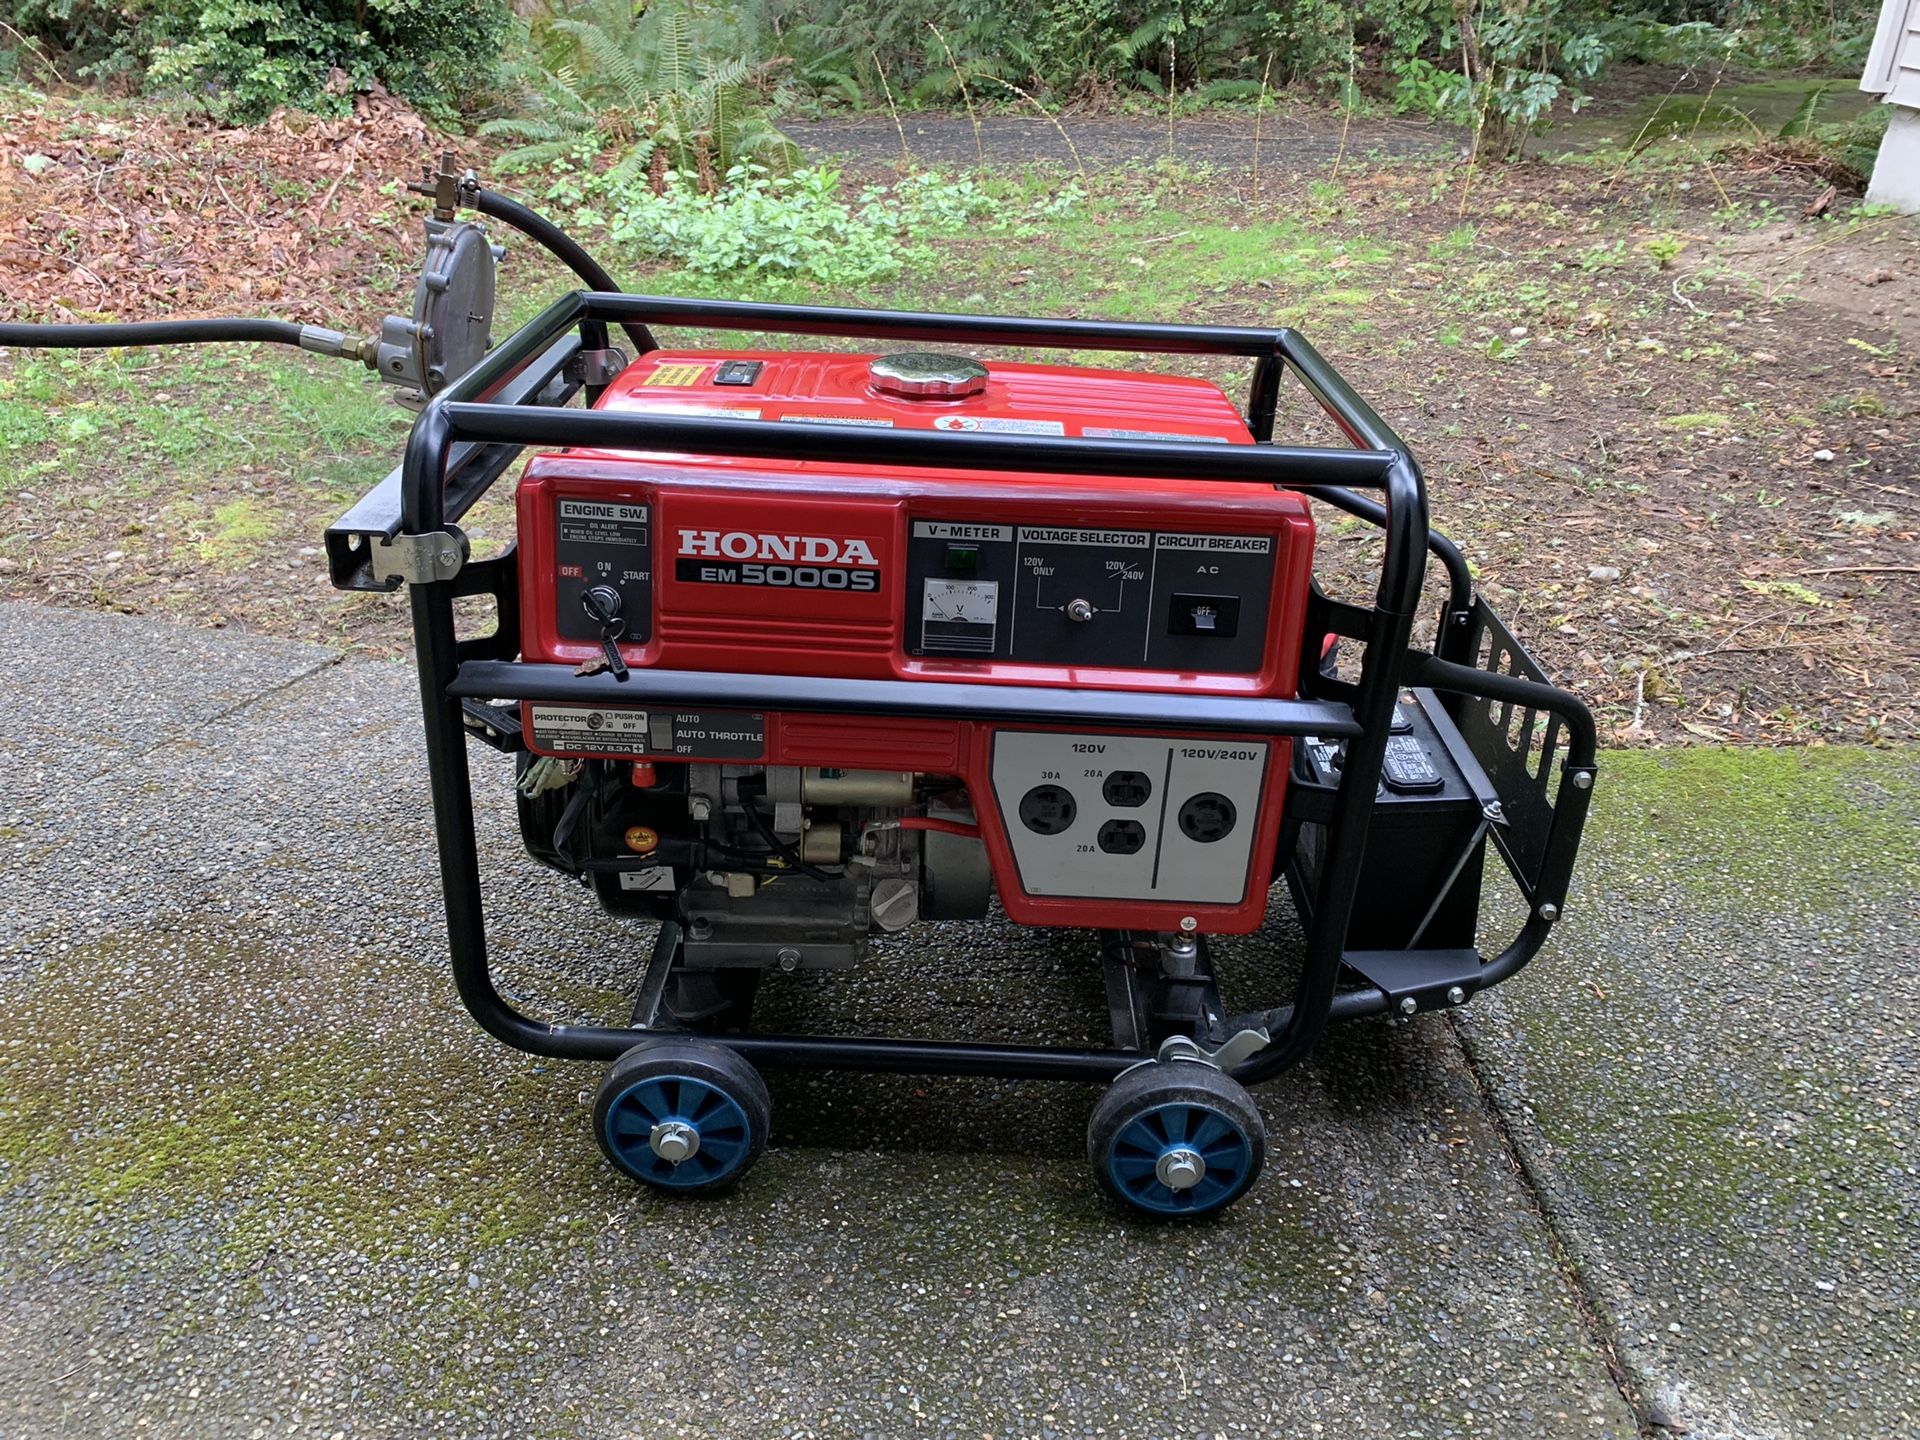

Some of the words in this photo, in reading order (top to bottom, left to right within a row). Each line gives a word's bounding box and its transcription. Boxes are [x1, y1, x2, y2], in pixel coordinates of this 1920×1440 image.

[564, 504, 614, 518] ENGINE
[620, 508, 645, 520] SW.
[1022, 529, 1077, 542] VOLTAGE
[1080, 532, 1146, 546] SELECTOR
[678, 529, 879, 565] HONDA
[1157, 536, 1207, 548] CIRCUIT
[1209, 538, 1268, 551] BREAKER
[597, 562, 612, 571] ON
[1023, 557, 1044, 567] 120V
[561, 567, 579, 576] OFF
[623, 571, 650, 581] START
[1033, 566, 1055, 576] ONLY
[1122, 570, 1144, 580] 240V
[742, 564, 875, 590] 5000S
[956, 604, 964, 612] V
[1196, 606, 1211, 616] OFF
[534, 714, 587, 723] PROTECTOR
[614, 713, 645, 721] PUSH-ON
[676, 714, 700, 724] AUTO
[676, 729, 705, 740] AUTO
[709, 731, 763, 742] THROTTLE
[676, 745, 693, 754] OFF
[1071, 743, 1106, 754] 120V
[1180, 748, 1258, 761] 120V/240V
